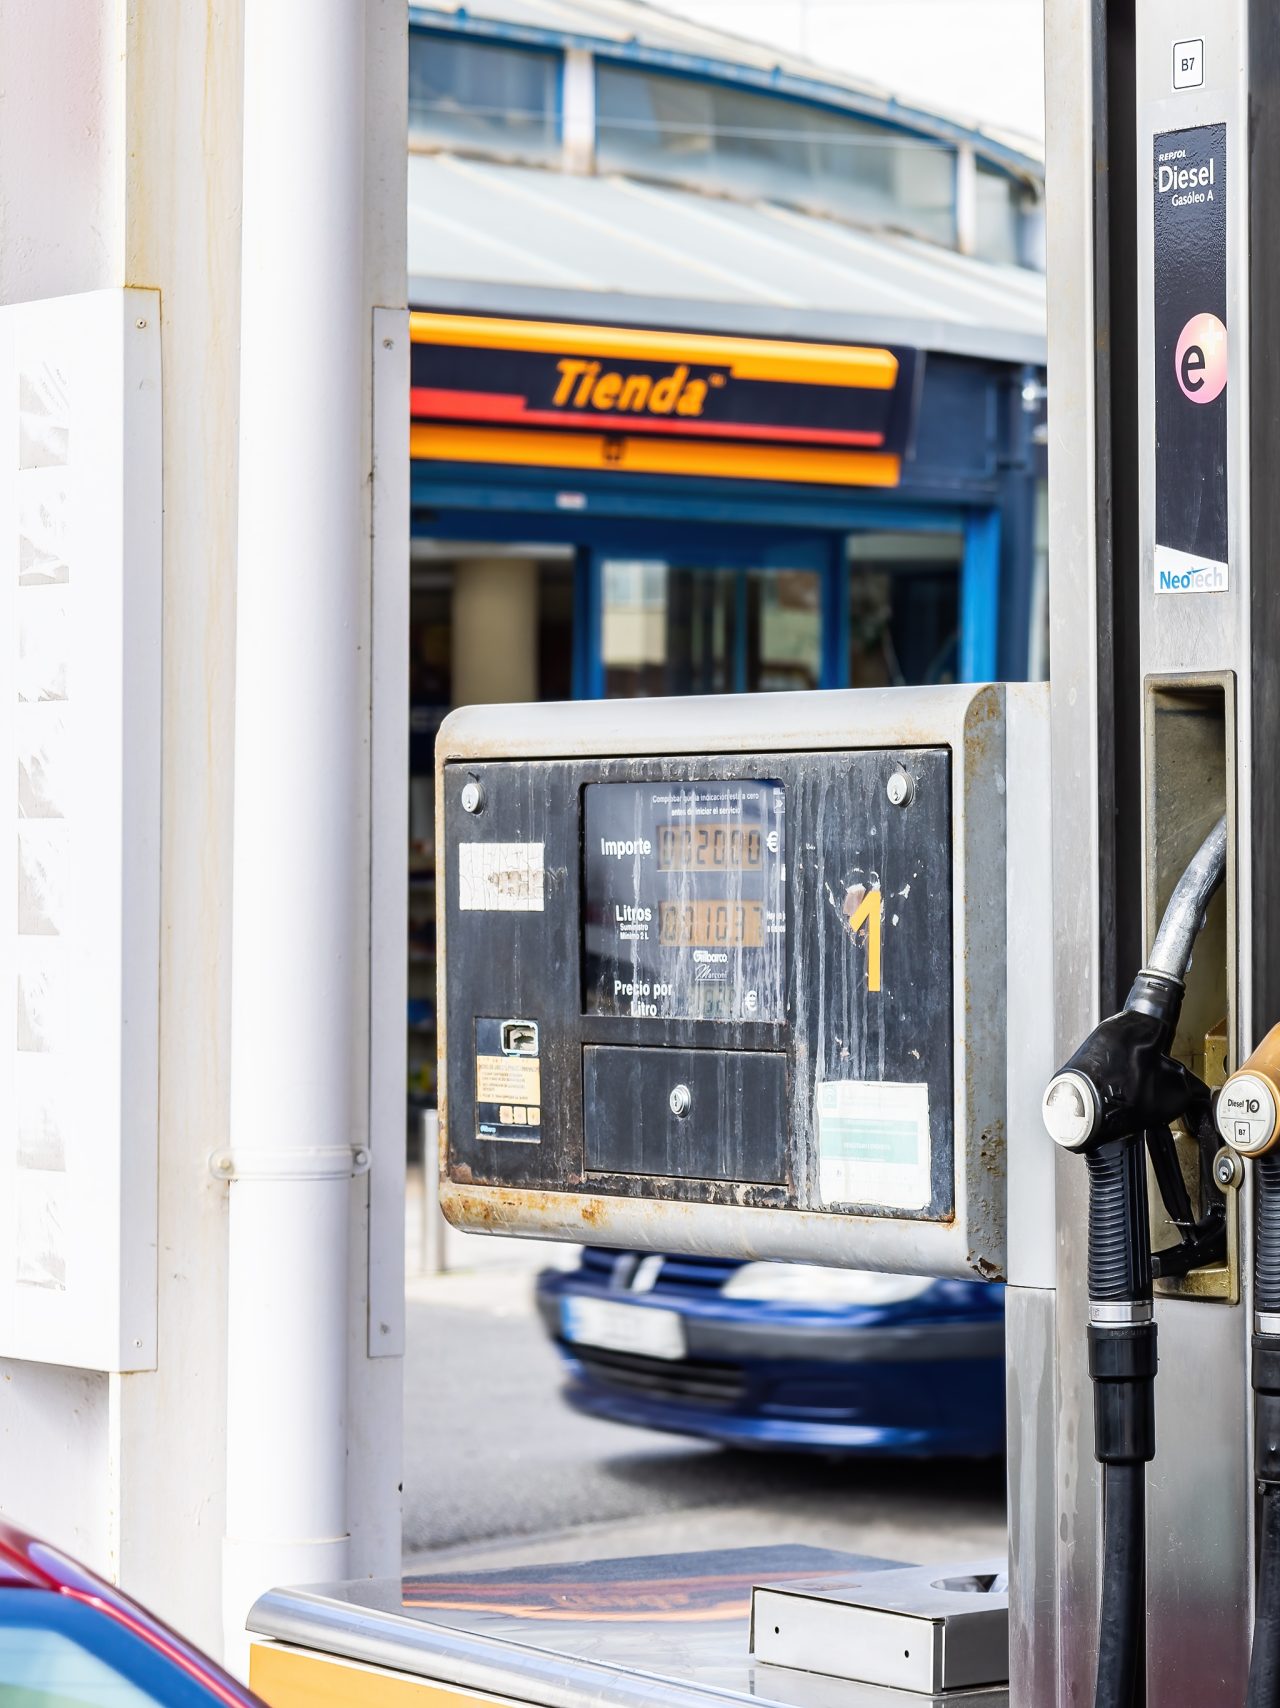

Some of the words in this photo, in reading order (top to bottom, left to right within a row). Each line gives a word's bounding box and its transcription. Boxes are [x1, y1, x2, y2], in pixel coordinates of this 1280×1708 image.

[1181, 57, 1195, 72] B7
[1158, 149, 1187, 162] REPSOL
[1158, 157, 1214, 193] Diesel
[1172, 190, 1205, 207] Gasóleo
[1206, 189, 1214, 202] A
[1180, 345, 1206, 393] e
[552, 359, 708, 417] Tienda
[600, 837, 652, 859] Importe
[615, 904, 652, 922] Litros
[619, 922, 649, 932] Suministro
[849, 888, 881, 992] 1
[614, 980, 650, 996] Precio
[653, 982, 673, 999] por
[630, 1000, 657, 1017] Litro
[1227, 1098, 1245, 1108] Diesel
